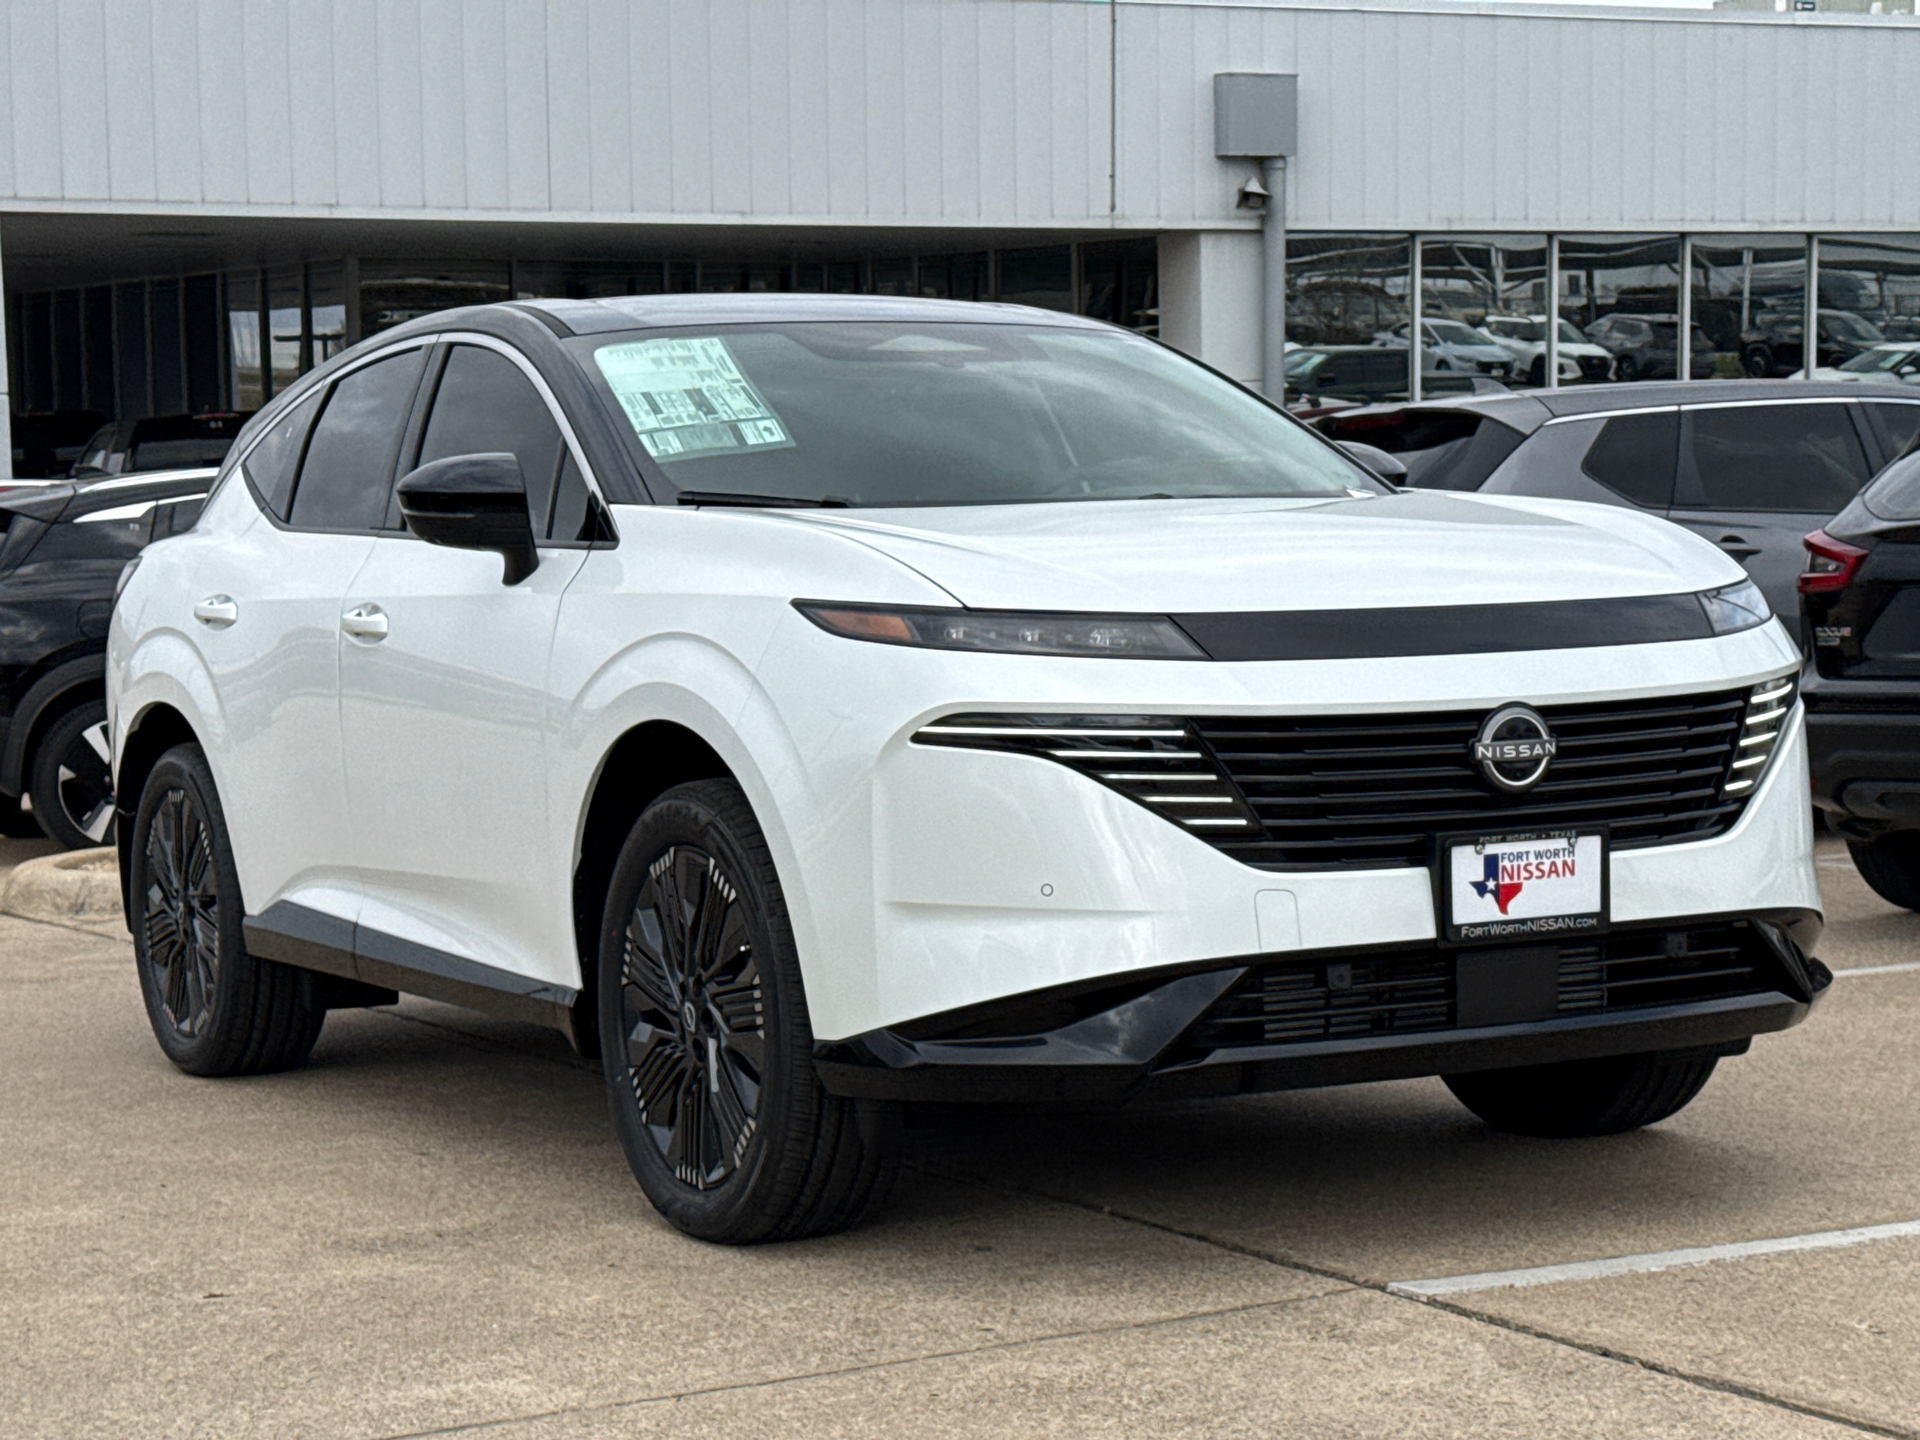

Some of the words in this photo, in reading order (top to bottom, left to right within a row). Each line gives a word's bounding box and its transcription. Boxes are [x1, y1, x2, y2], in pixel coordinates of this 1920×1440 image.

[1477, 740, 1556, 758] NISSAN
[1506, 832, 1537, 843] WORTH
[1549, 829, 1577, 839] TEXAS
[1500, 851, 1531, 863] FORT
[1534, 847, 1575, 861] WORTH
[1501, 859, 1575, 882] NISSAN
